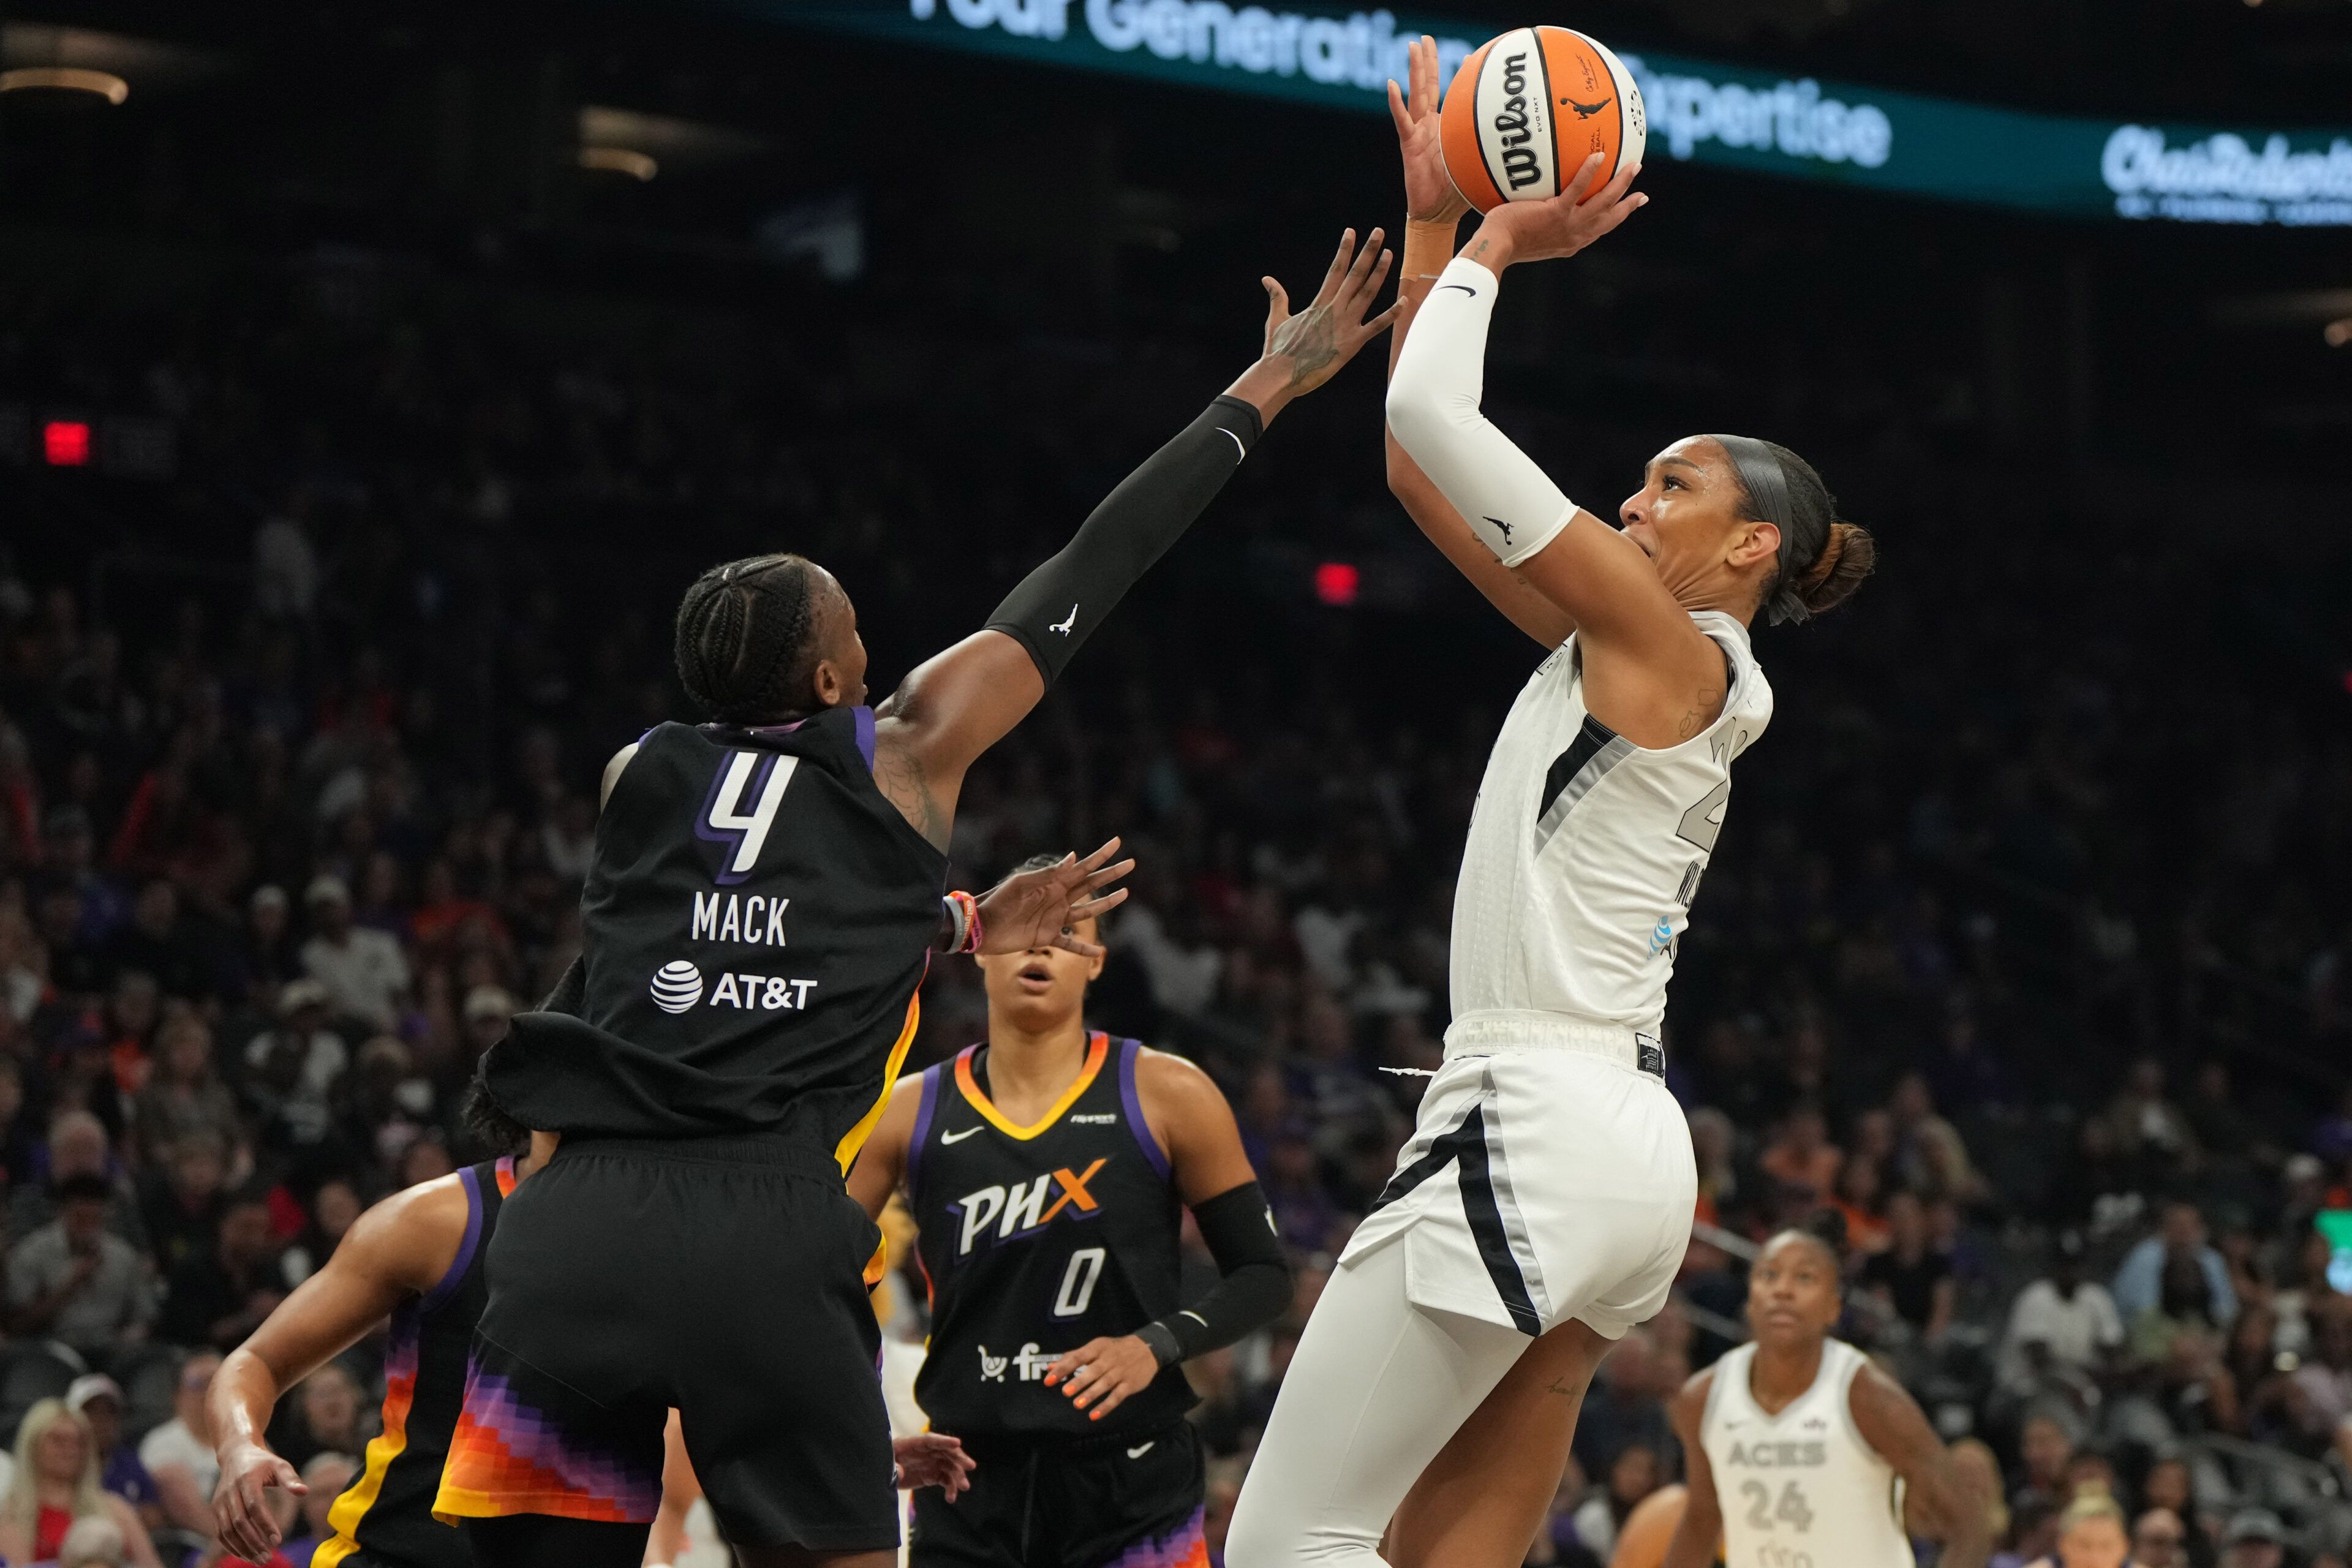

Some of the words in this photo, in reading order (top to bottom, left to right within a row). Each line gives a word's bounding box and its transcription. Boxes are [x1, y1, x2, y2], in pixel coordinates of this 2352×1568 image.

[910, 0, 1067, 41] our
[1617, 53, 1891, 167] xpertise
[1494, 51, 1542, 191] Wilson
[704, 750, 799, 876] 4
[692, 891, 790, 946] MACK
[710, 973, 818, 1010] AT&T
[957, 1158, 1107, 1256] PHX
[1054, 1248, 1106, 1317] 0
[1727, 1442, 1826, 1468] ACES
[1740, 1479, 1814, 1533] 24
